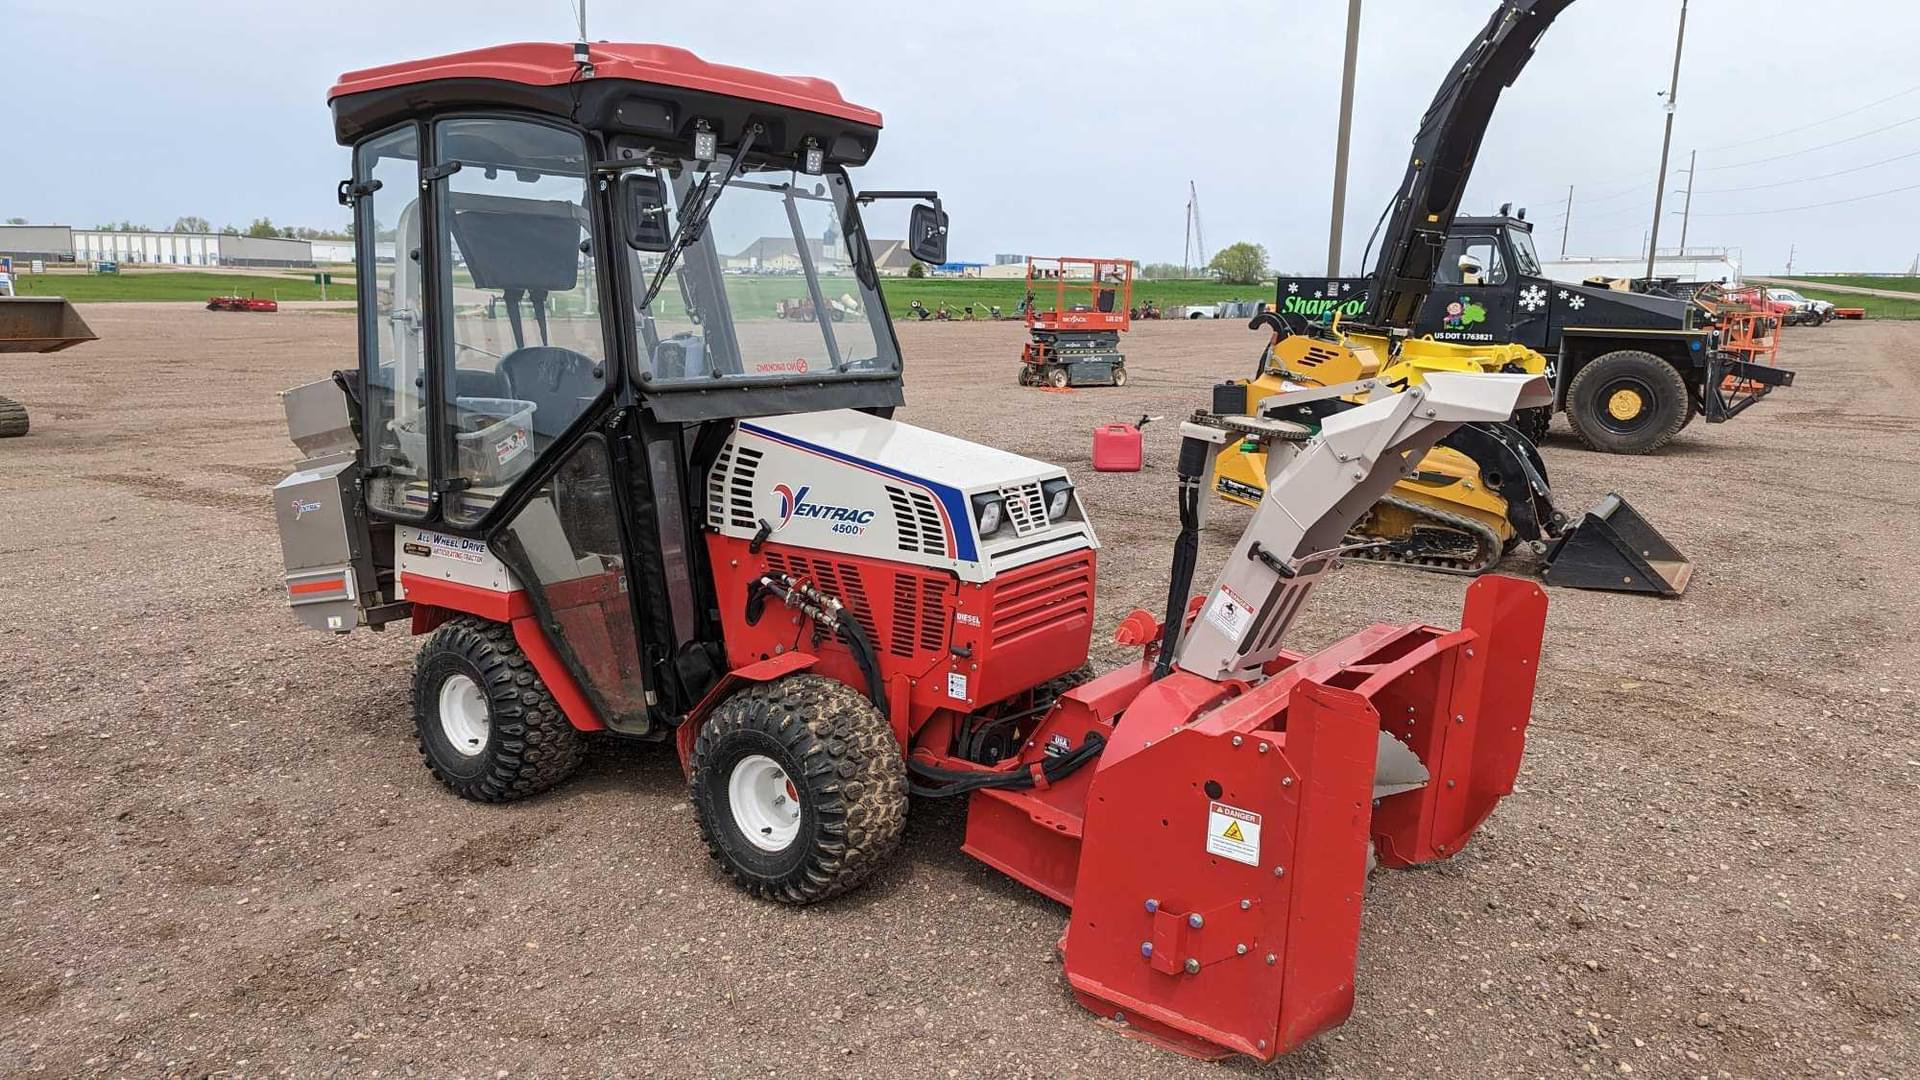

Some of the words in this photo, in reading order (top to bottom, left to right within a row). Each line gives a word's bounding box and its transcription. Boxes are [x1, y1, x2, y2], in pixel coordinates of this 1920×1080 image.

[1445, 332, 1461, 340] DOT
[773, 484, 875, 532] VENTRAC
[433, 533, 459, 548] WHEEL
[461, 539, 486, 553] DRIVE
[956, 612, 980, 624] DIESEL
[1224, 808, 1256, 823] DANGER
